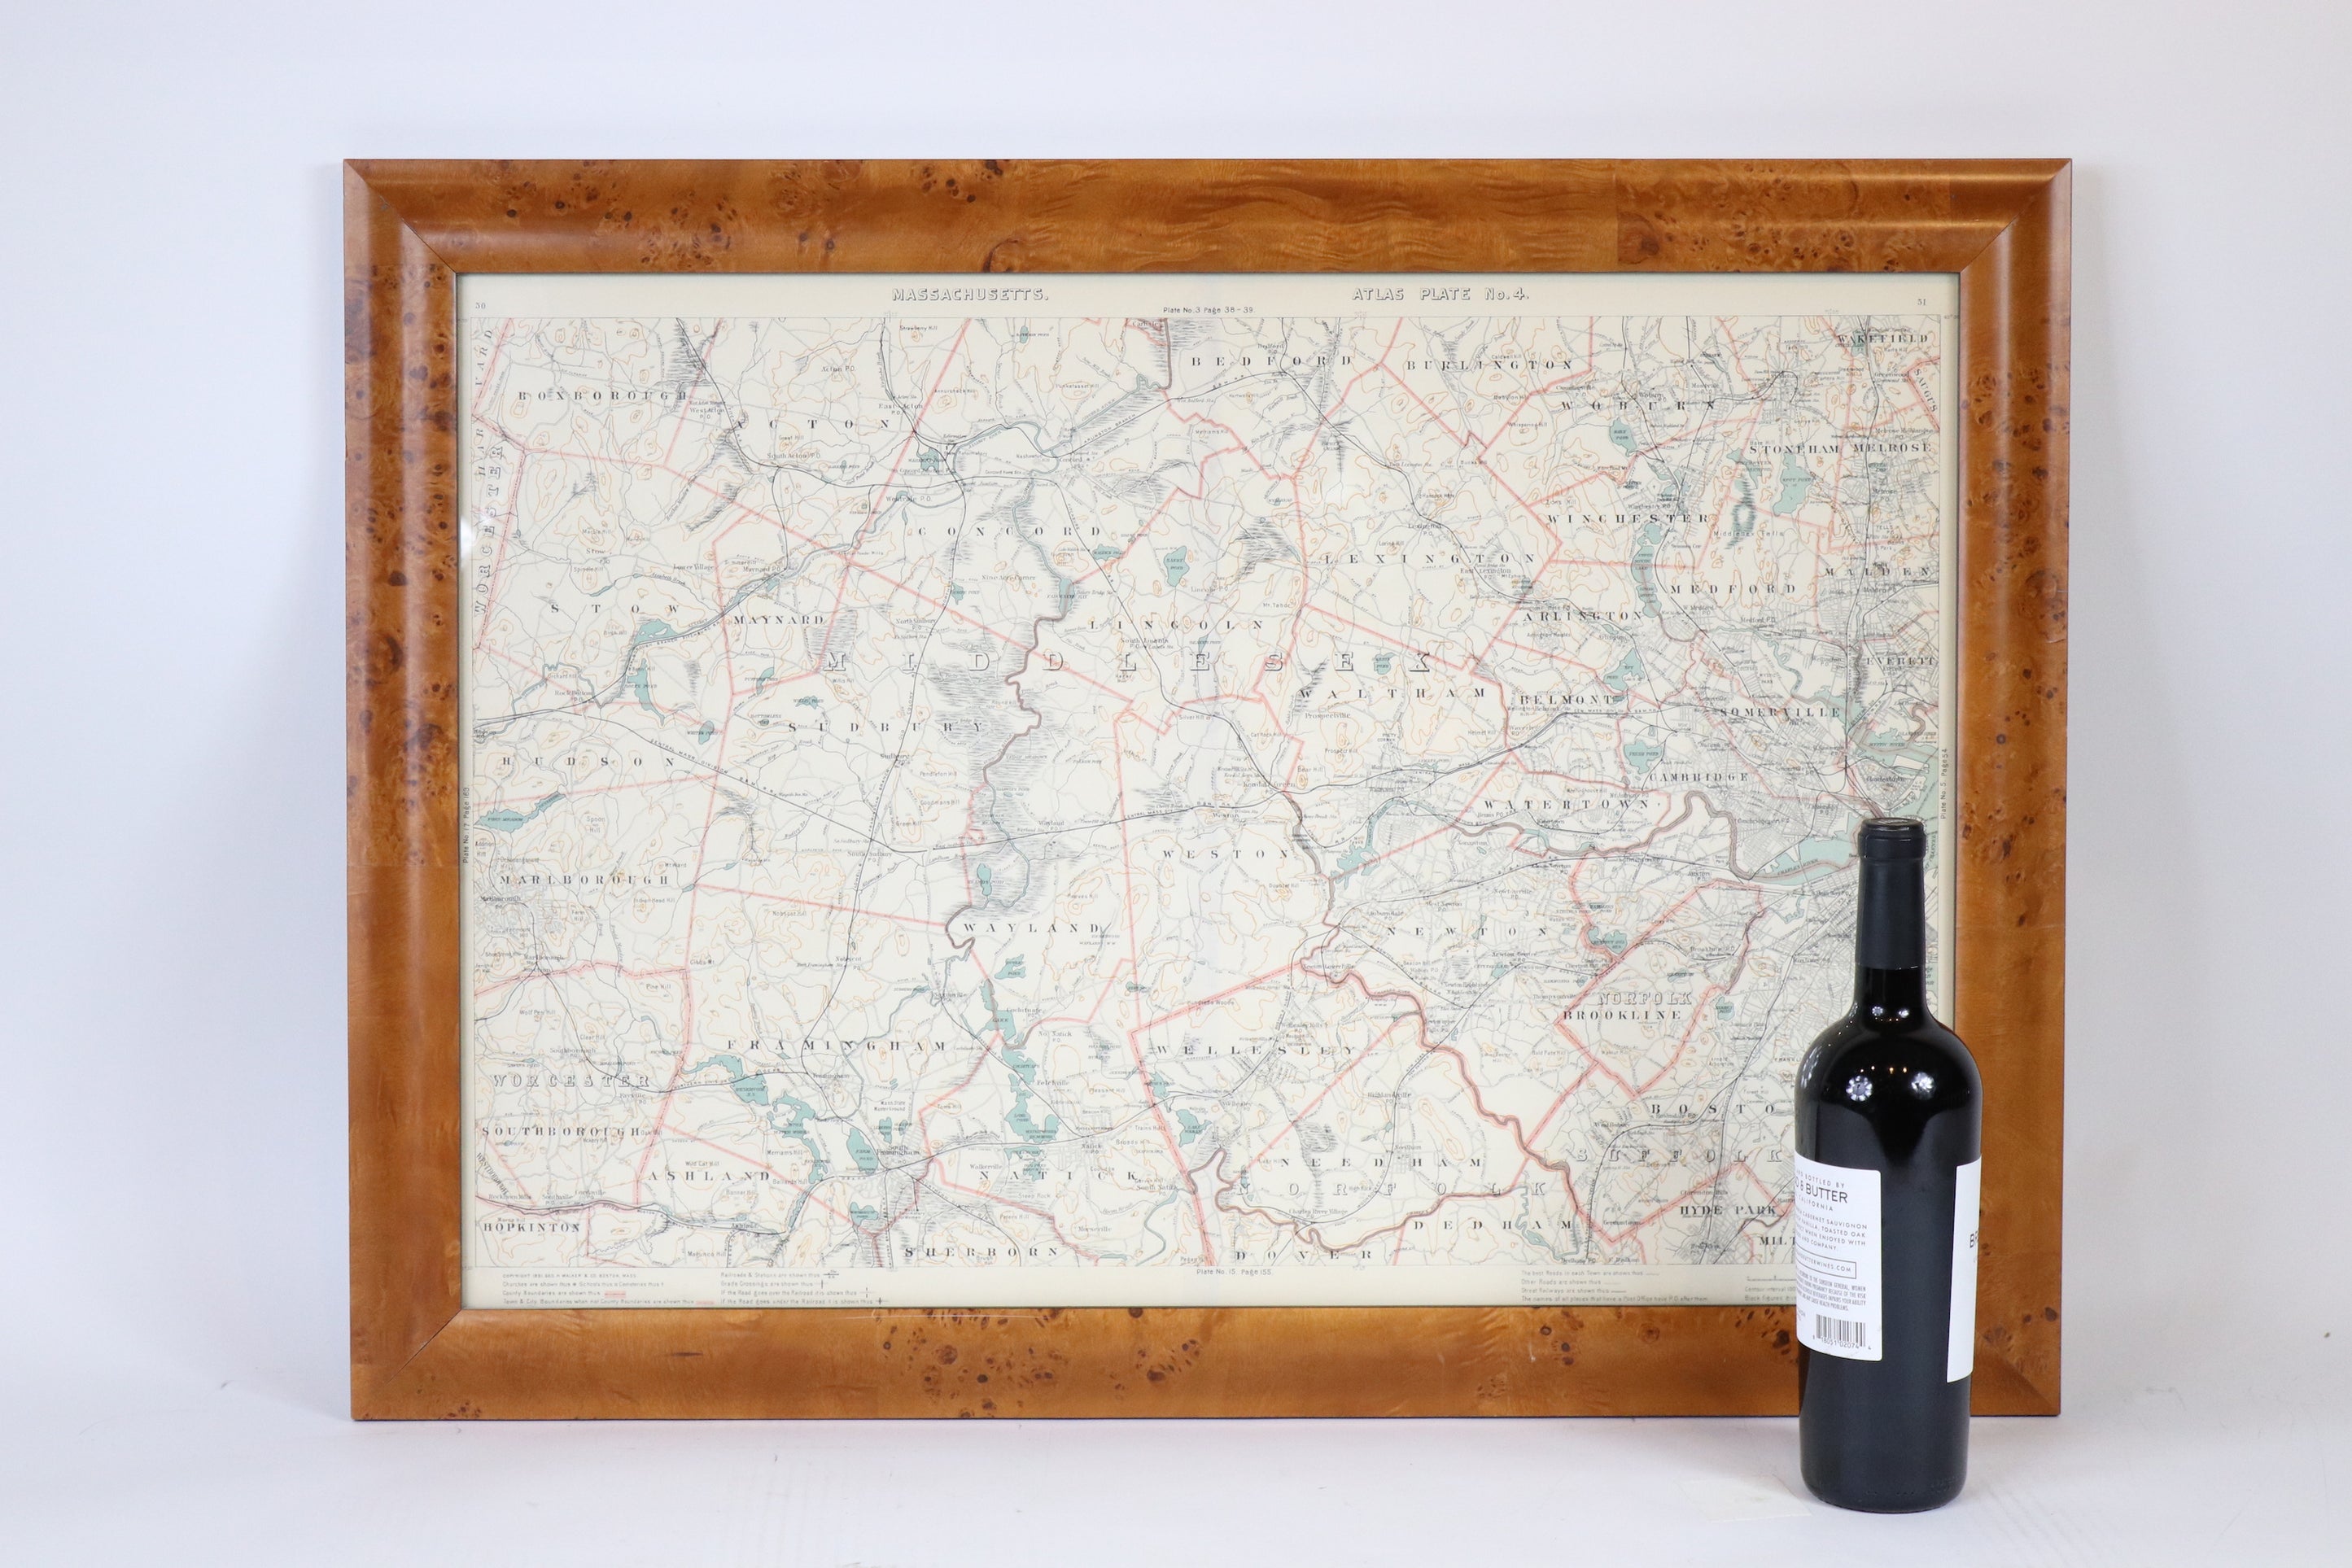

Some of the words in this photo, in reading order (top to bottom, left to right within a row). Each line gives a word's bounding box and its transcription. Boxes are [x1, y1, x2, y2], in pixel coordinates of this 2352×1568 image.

[892, 288, 1049, 301] MASSACHUSETTS.
[1352, 287, 1404, 300] ATLAS
[1420, 287, 1471, 300] PLATE
[1917, 298, 1927, 306] 51
[1163, 306, 1181, 314] Plate
[1204, 307, 1221, 316] Page
[1838, 334, 1929, 343] WAKEFIELD
[1191, 356, 1350, 366] BEDFORD
[1407, 360, 1572, 370] BURLINGTON
[518, 391, 689, 400] BOXBOROUGH
[1562, 401, 1715, 410] WOBURN
[1750, 444, 1839, 454] STONEHAM
[1853, 443, 1931, 452] MELROSE
[1548, 513, 1708, 523] WINCHESTER
[919, 526, 1099, 535] CONCORD
[1325, 554, 1533, 563] LEXINGTON
[1825, 567, 1929, 576] MALDEN
[1671, 584, 1795, 593] MEDFORD
[551, 605, 679, 614] STOW
[734, 615, 824, 625] MAYNARD
[1523, 612, 1642, 622] ARLINGTON
[1091, 620, 1262, 630] LINCOLN
[1866, 657, 1935, 666] EVERETT
[1300, 688, 1484, 699] WALTHAM
[1520, 695, 1613, 705] BELMONT
[1720, 708, 1840, 717] SOMERVILLE
[789, 723, 982, 732] SUDBURY
[502, 757, 673, 766] HUDSON
[1650, 772, 1748, 782] CAMBRIDGE
[1484, 800, 1650, 810] WATERTOWN
[1164, 850, 1288, 858] WESTON
[501, 875, 667, 884] MARLBOROUGH
[964, 924, 1099, 933] WAYLAND
[1388, 927, 1546, 936] NEWTON
[1598, 992, 1693, 1006] NORFOLK
[1563, 1010, 1681, 1020] BROOKLINE
[728, 1040, 946, 1051] FRAMINGHAM
[1157, 1045, 1355, 1055] WELLESLEY
[493, 1074, 650, 1088] WORCESTER
[483, 1126, 641, 1136] SOUTHBOROUGH
[1282, 1158, 1484, 1168] NEEDHAM
[650, 1172, 770, 1181] ASHLAND
[980, 1172, 1136, 1180] NATICK
[1804, 1174, 1831, 1186] BOTTLED
[1806, 1183, 1848, 1203] BUTTER
[1680, 1206, 1722, 1215] HYDE
[1736, 1206, 1775, 1215] PARK
[483, 1223, 580, 1233] HOPKINTON
[1826, 1219, 1868, 1230] SAUVIGNON
[1821, 1226, 1848, 1236] TOASTED
[1819, 1234, 1846, 1244] ENJOYED
[905, 1247, 1057, 1257] SHERBORN
[1237, 1251, 1371, 1260] DOVER
